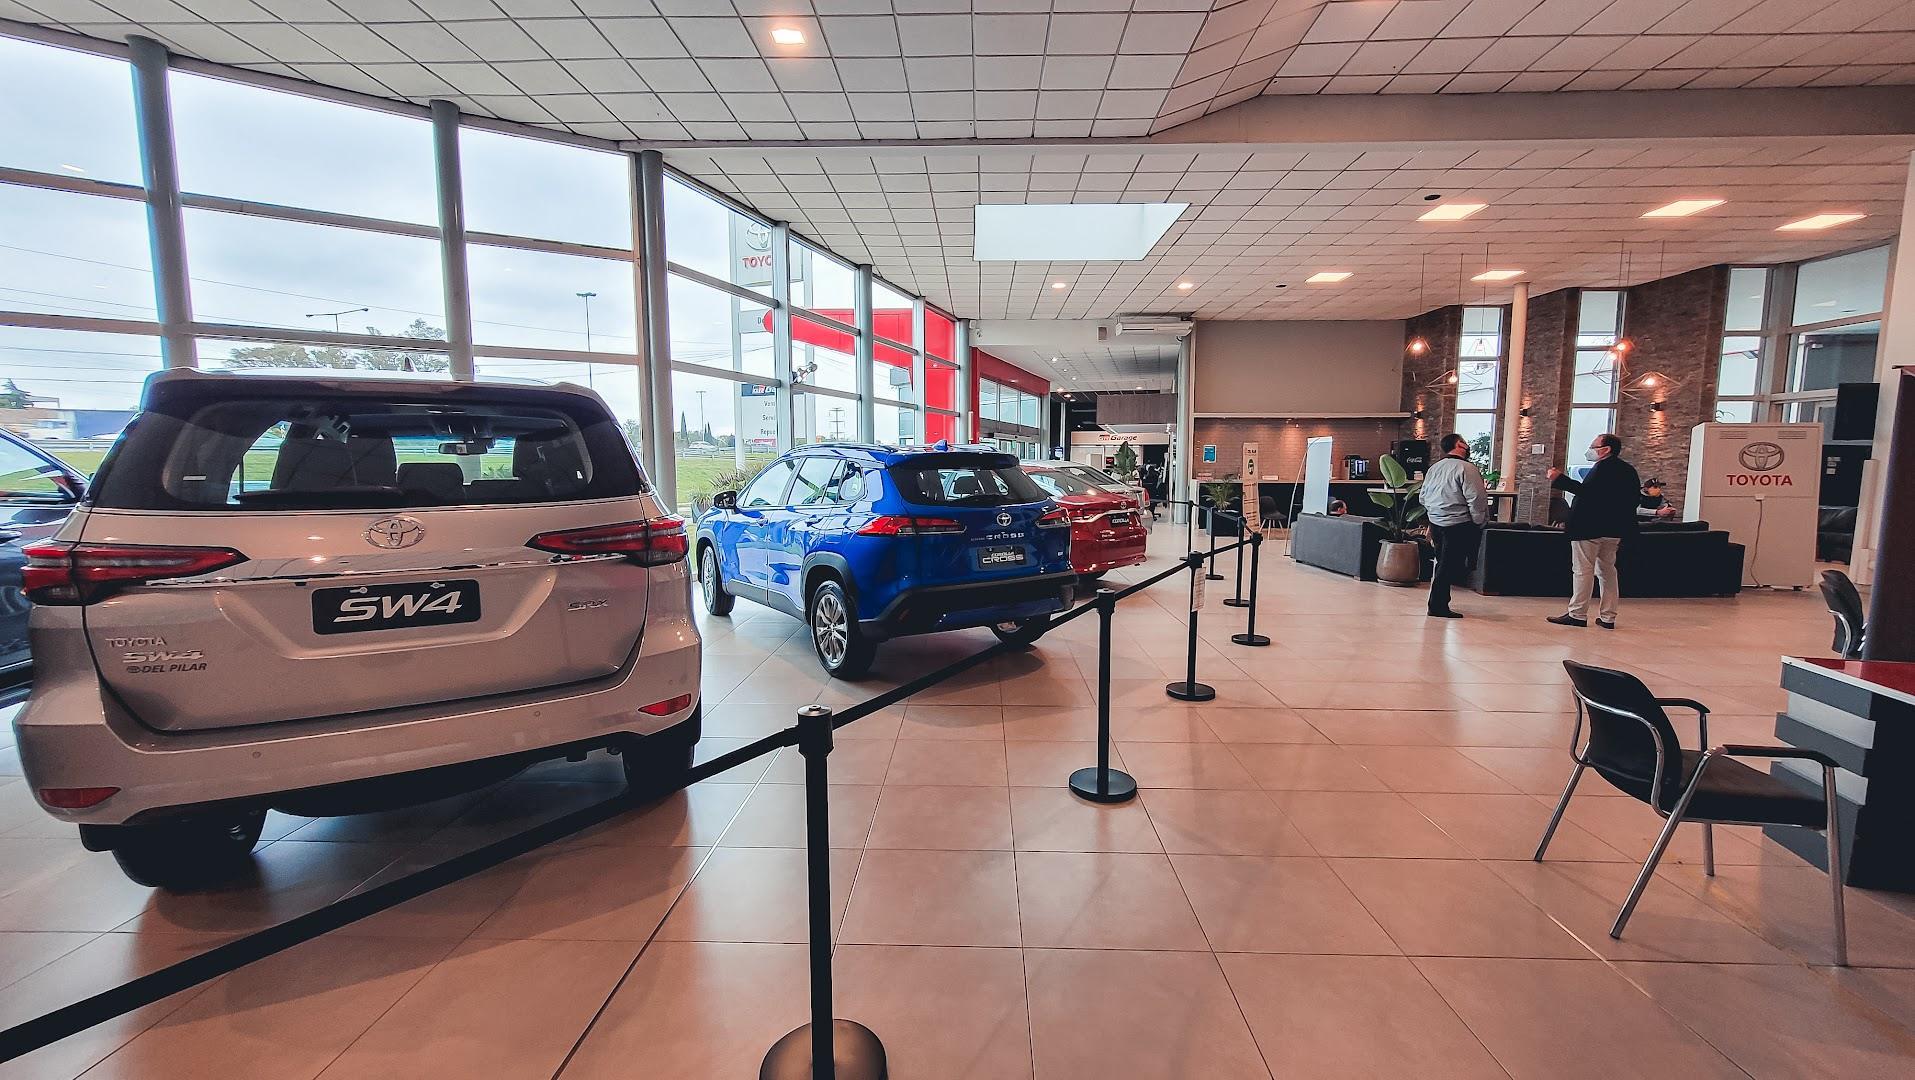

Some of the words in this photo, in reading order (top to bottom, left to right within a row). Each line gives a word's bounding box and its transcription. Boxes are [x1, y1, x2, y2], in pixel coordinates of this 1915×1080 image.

[1726, 474, 1793, 486] TOYOTA
[982, 554, 1024, 564] CROSS
[332, 591, 463, 623] SW4
[567, 598, 609, 611] SRX
[105, 636, 168, 648] TOYOTA
[140, 665, 166, 674] DEL
[169, 662, 208, 673] PILAR
